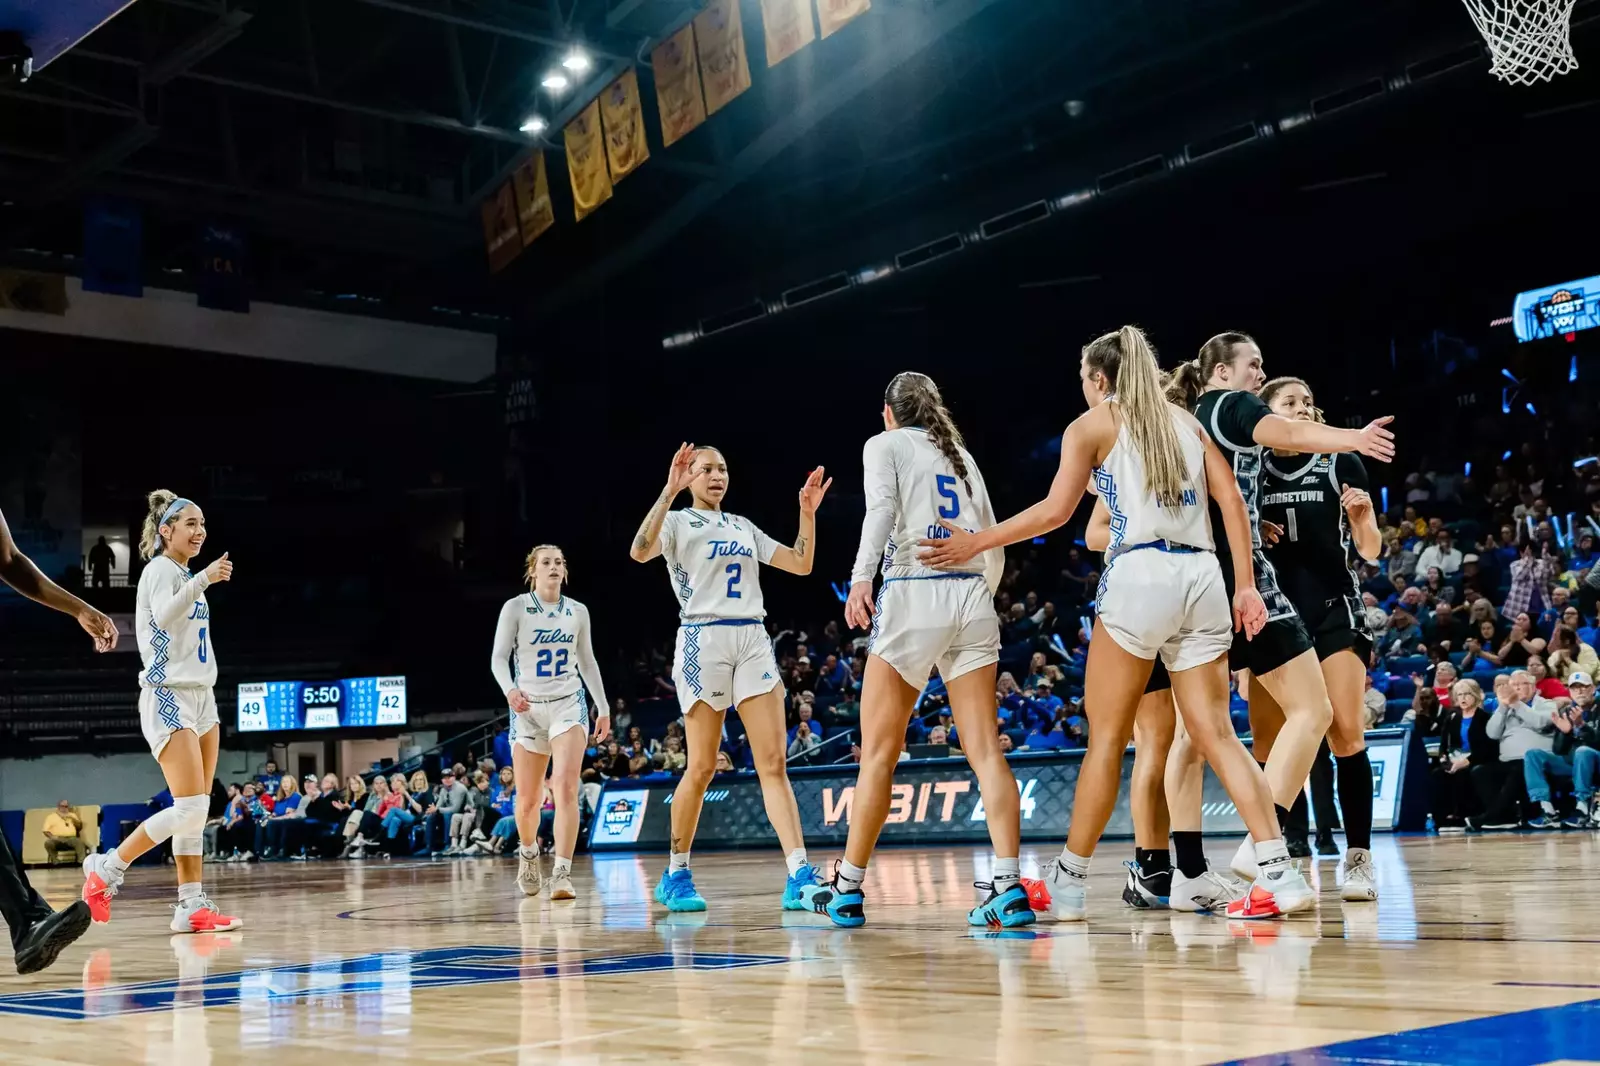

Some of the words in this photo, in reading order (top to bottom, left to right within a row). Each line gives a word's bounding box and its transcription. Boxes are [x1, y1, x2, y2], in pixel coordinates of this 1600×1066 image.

[935, 474, 960, 519] 5
[1286, 507, 1298, 542] 1
[706, 540, 753, 560] Tulsa
[725, 562, 742, 599] 2
[188, 601, 210, 620] Tul
[529, 628, 575, 646] Tulsa
[536, 648, 569, 678] 22
[379, 680, 404, 688] HOYAS
[303, 686, 340, 704] 5:50
[381, 696, 400, 709] 42
[242, 702, 260, 715] 49
[822, 780, 971, 826] WBIT
